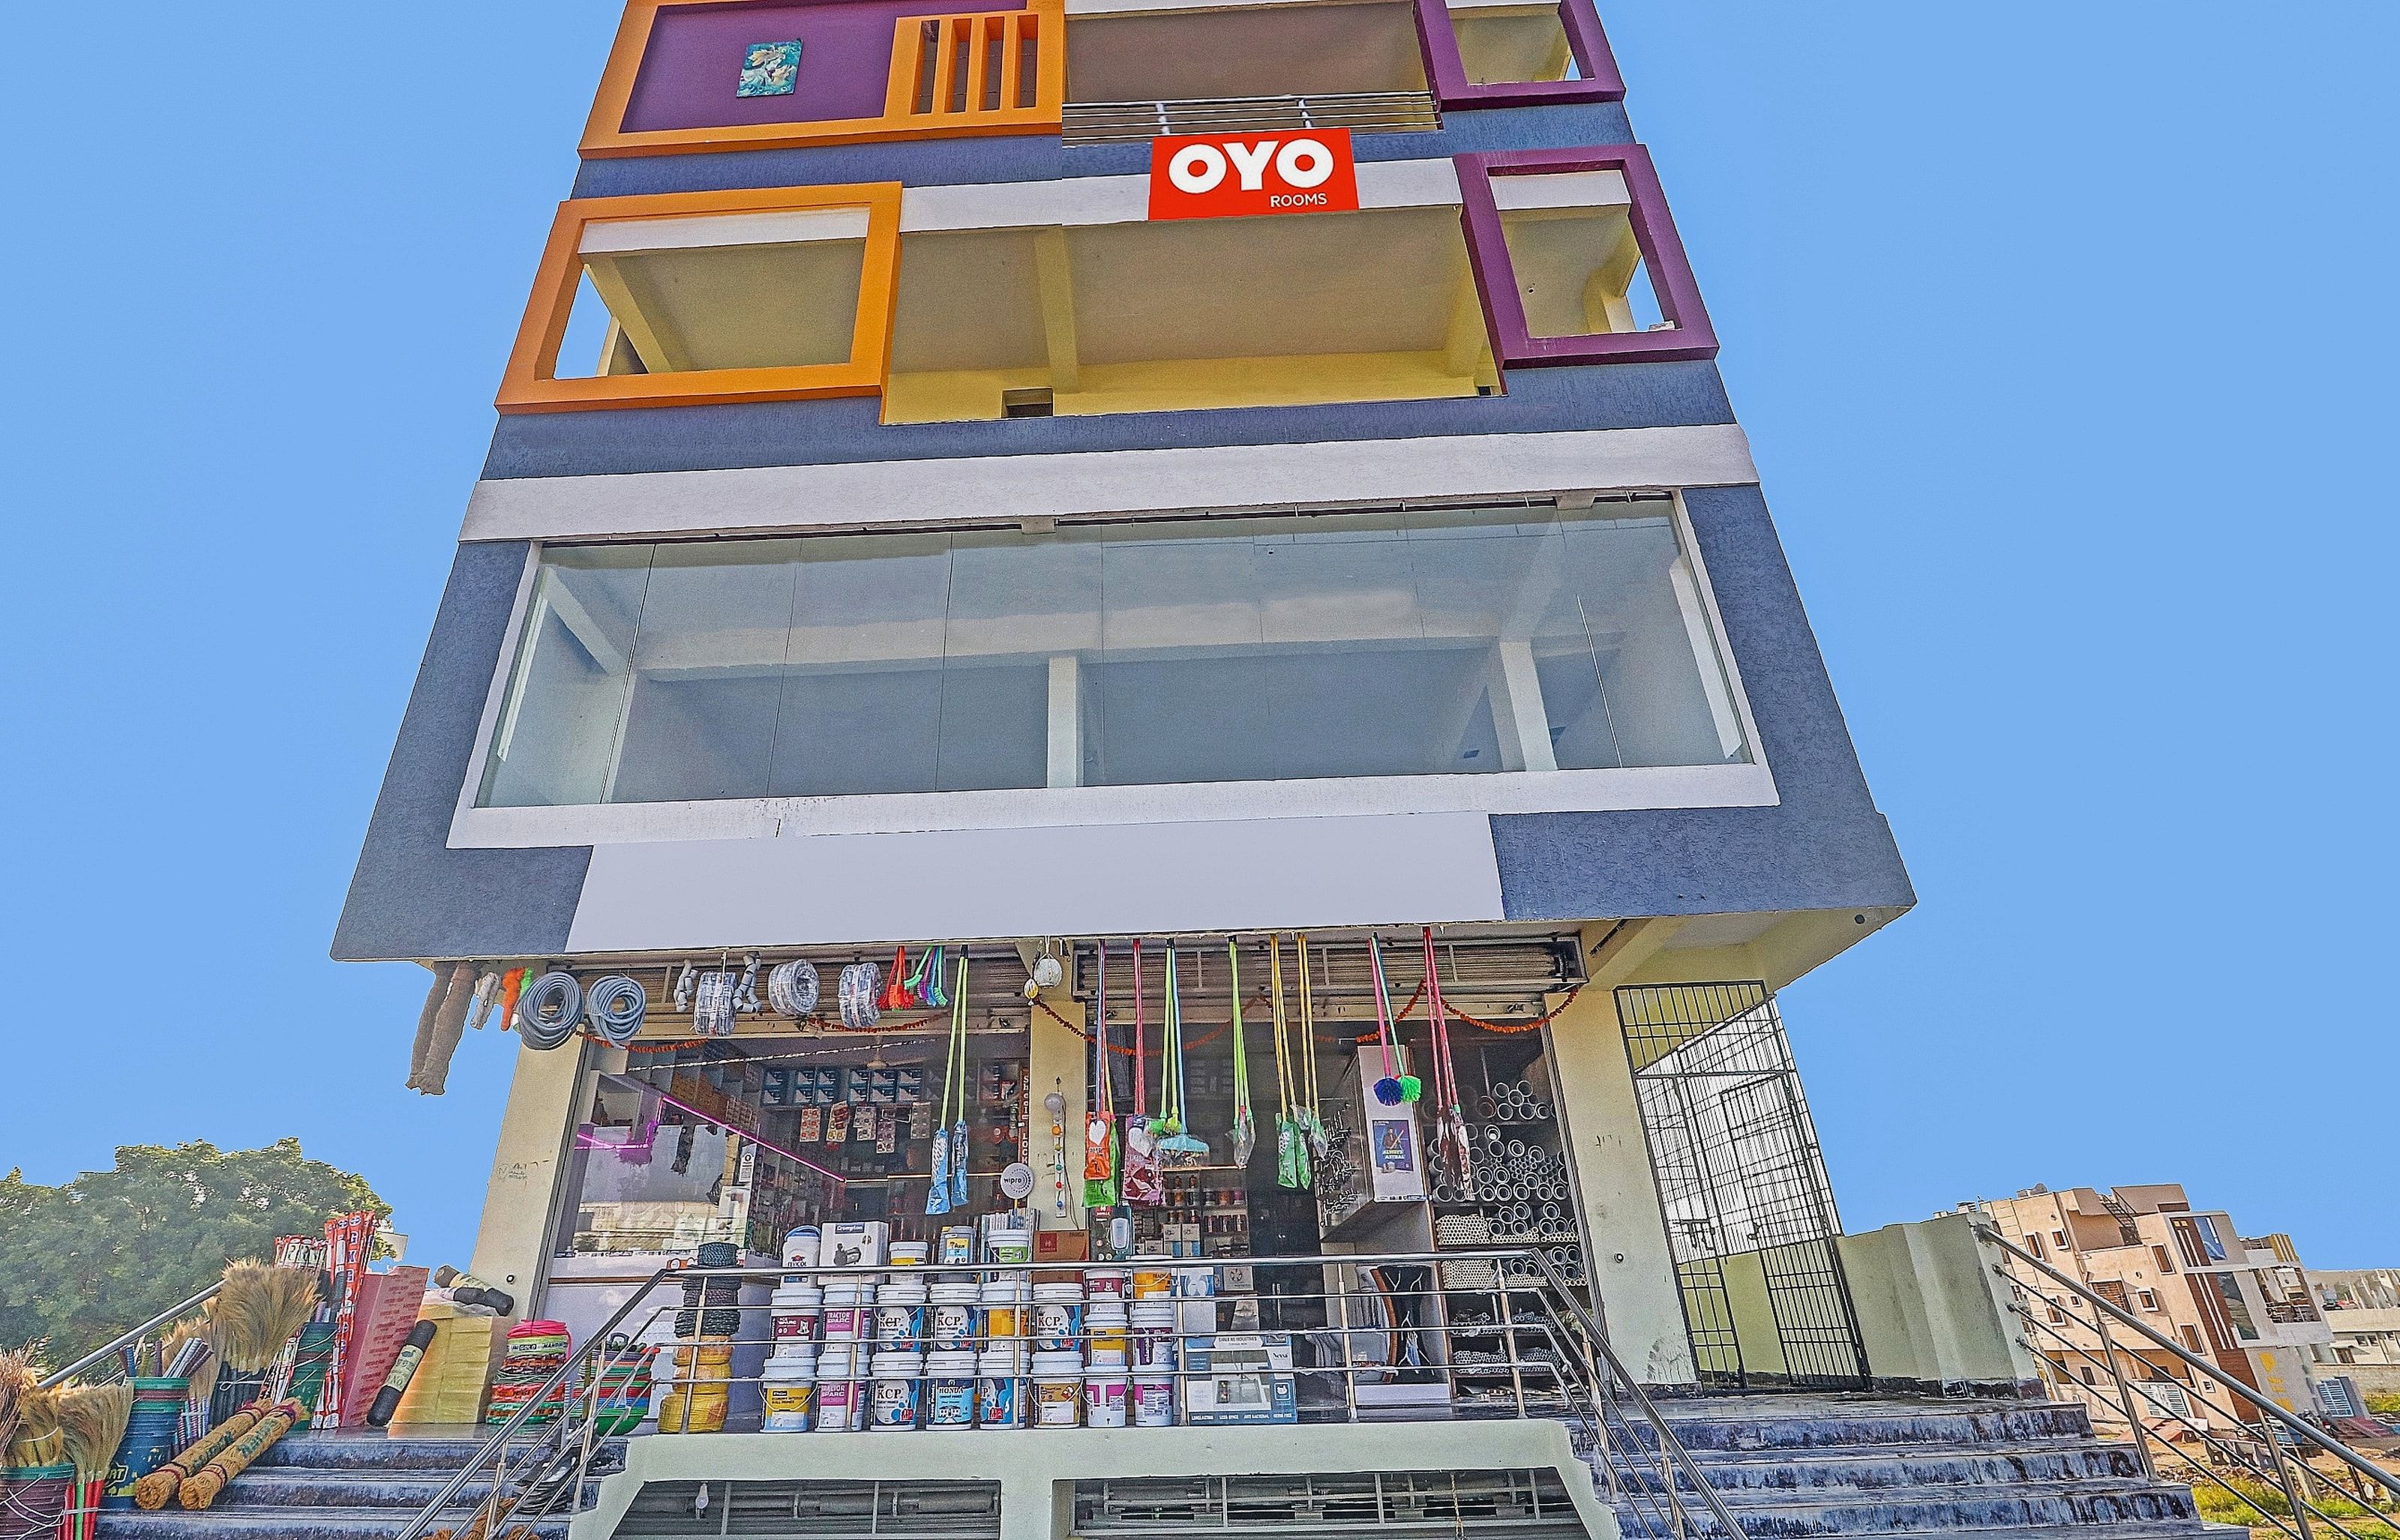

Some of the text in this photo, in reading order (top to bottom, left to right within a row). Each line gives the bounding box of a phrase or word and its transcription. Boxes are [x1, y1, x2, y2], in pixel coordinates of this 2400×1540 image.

[1168, 138, 1334, 193] OYO
[1270, 193, 1328, 208] ROOMS
[938, 1317, 961, 1326] KCP
[1038, 1317, 1060, 1326] KCP
[877, 1389, 902, 1399] KCP
